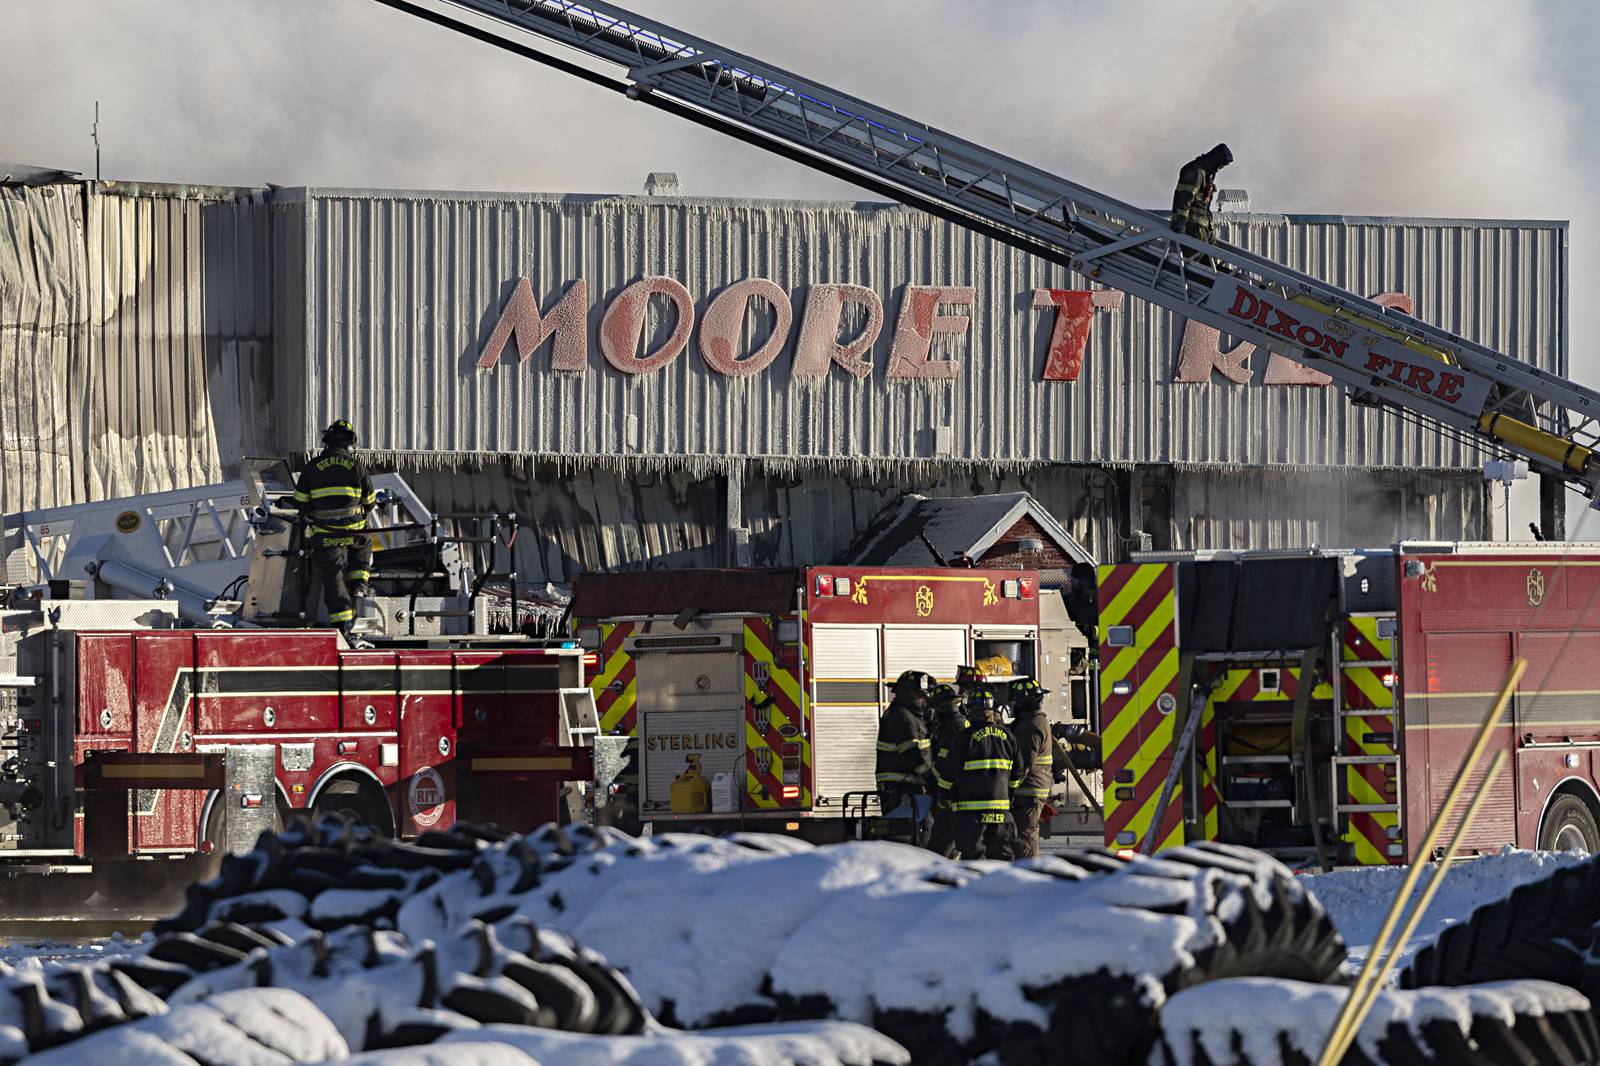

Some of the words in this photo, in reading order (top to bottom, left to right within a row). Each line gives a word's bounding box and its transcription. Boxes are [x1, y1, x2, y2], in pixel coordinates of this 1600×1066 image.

[476, 275, 975, 377] MOORE
[1227, 284, 1350, 359] DIXON
[1363, 351, 1465, 405] FIRE
[1579, 397, 1590, 406] 70
[316, 456, 354, 472] STERLING
[240, 496, 250, 506] 65
[322, 536, 354, 547] SIMPSON
[973, 727, 1007, 742] STERLING
[647, 734, 740, 751] STERLING
[417, 790, 437, 802] RIT
[981, 813, 1005, 824] ZIGLER
